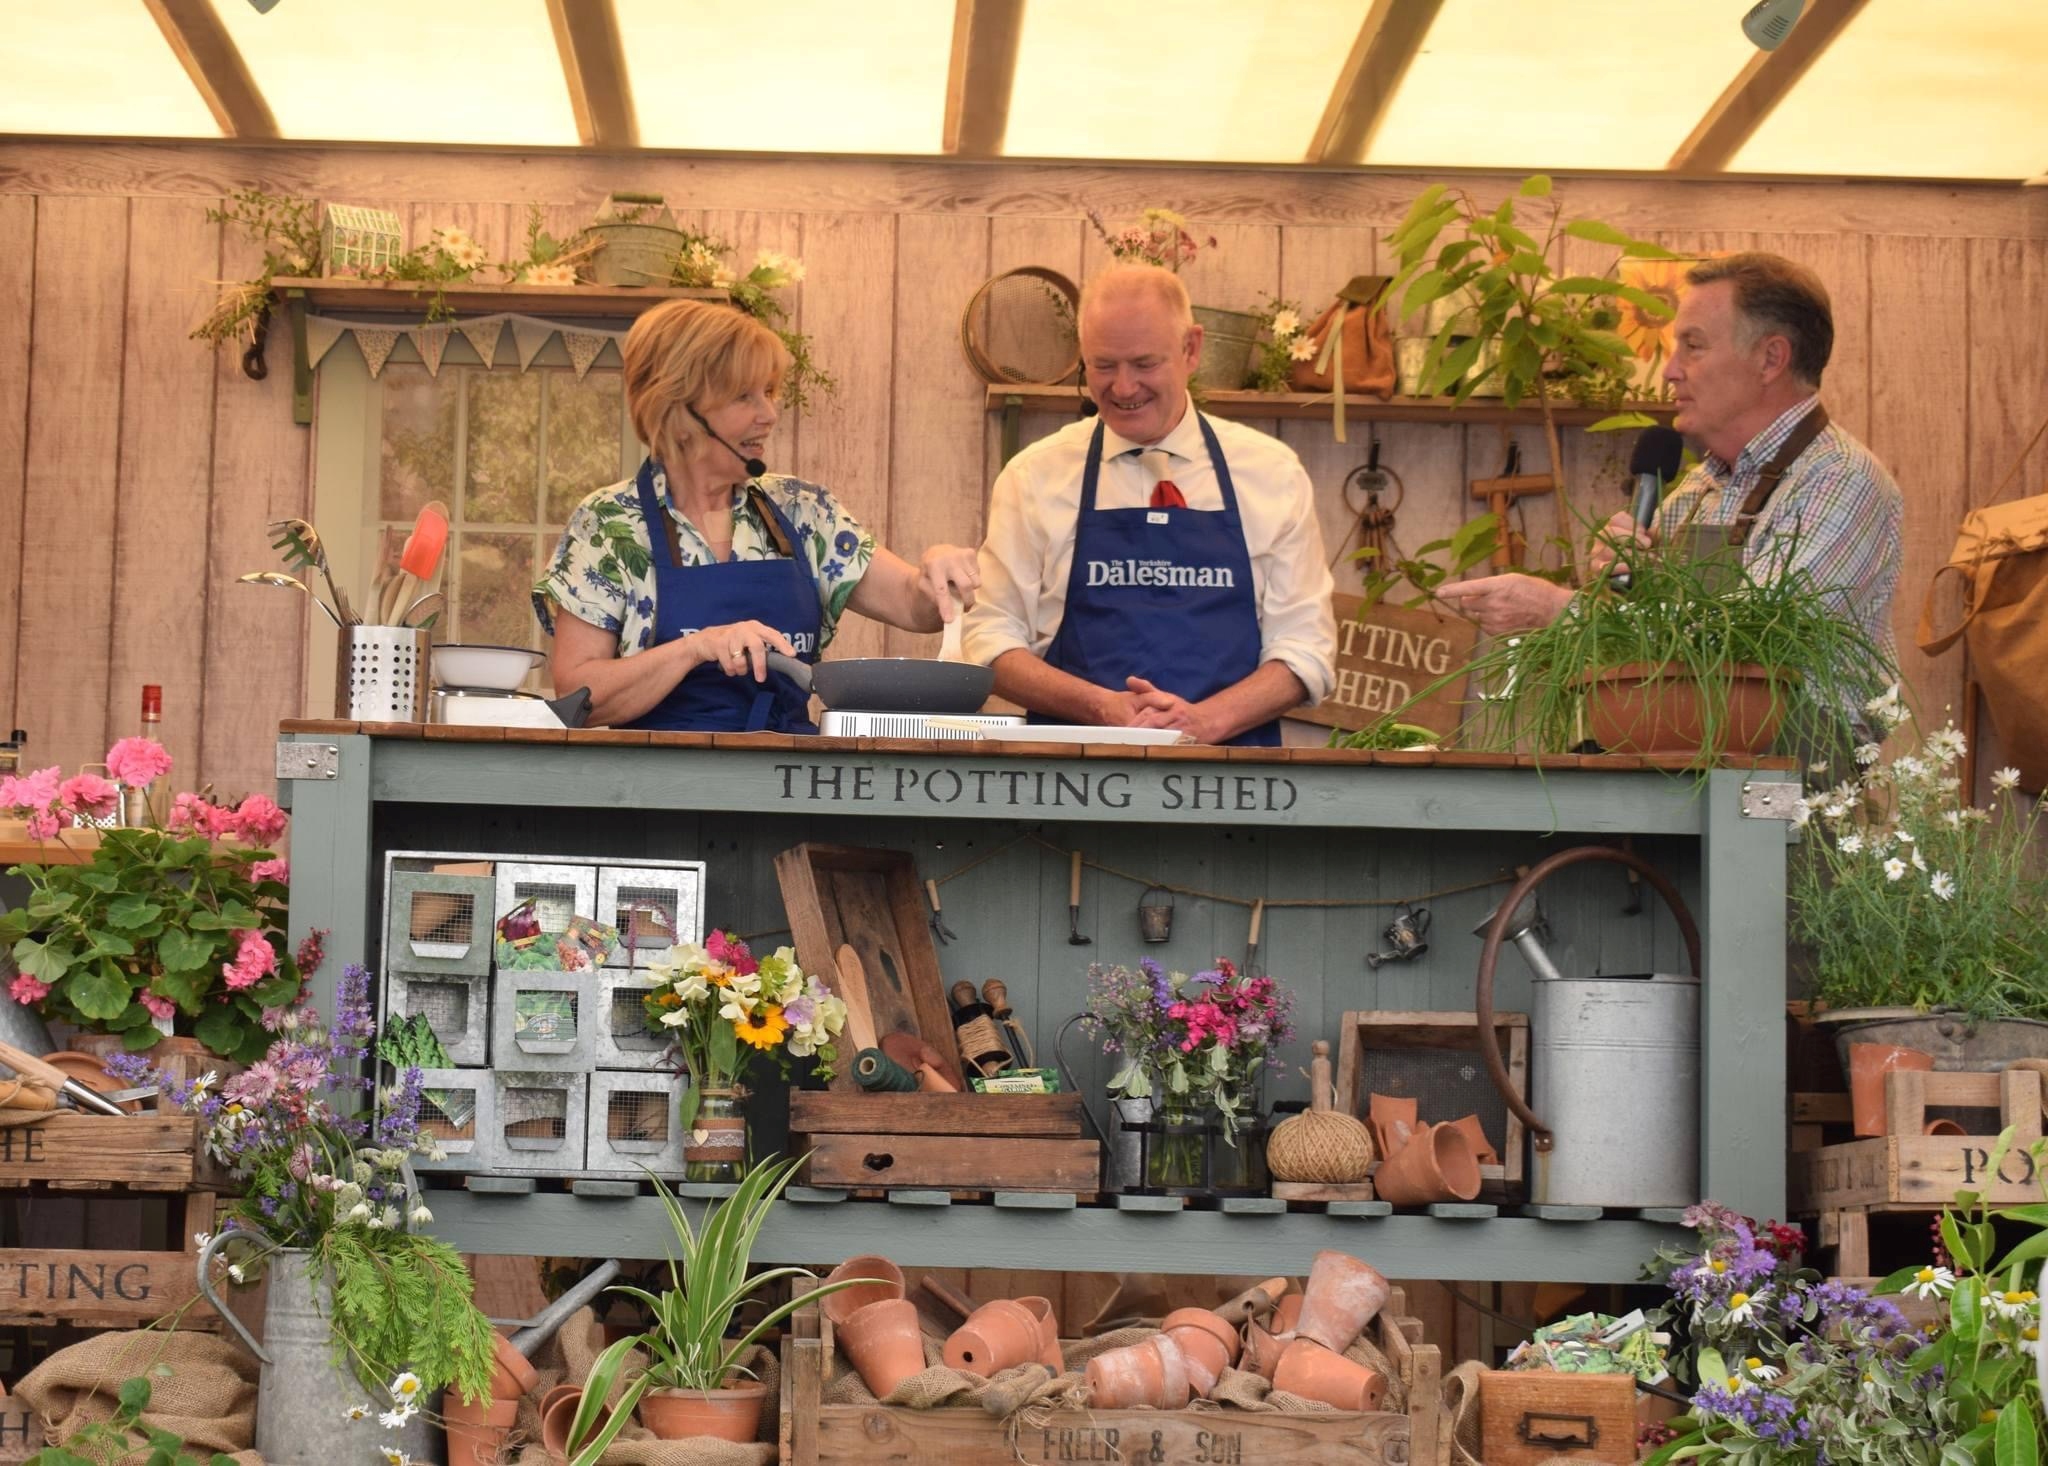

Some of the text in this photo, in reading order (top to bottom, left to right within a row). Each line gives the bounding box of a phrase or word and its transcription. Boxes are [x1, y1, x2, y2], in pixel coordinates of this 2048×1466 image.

[1086, 560, 1234, 588] Dalesman
[775, 765, 1298, 811] THE POTTING SHED
[0, 1263, 153, 1300] TING
[1150, 1430, 1165, 1463] &
[1195, 1431, 1241, 1465] SON
